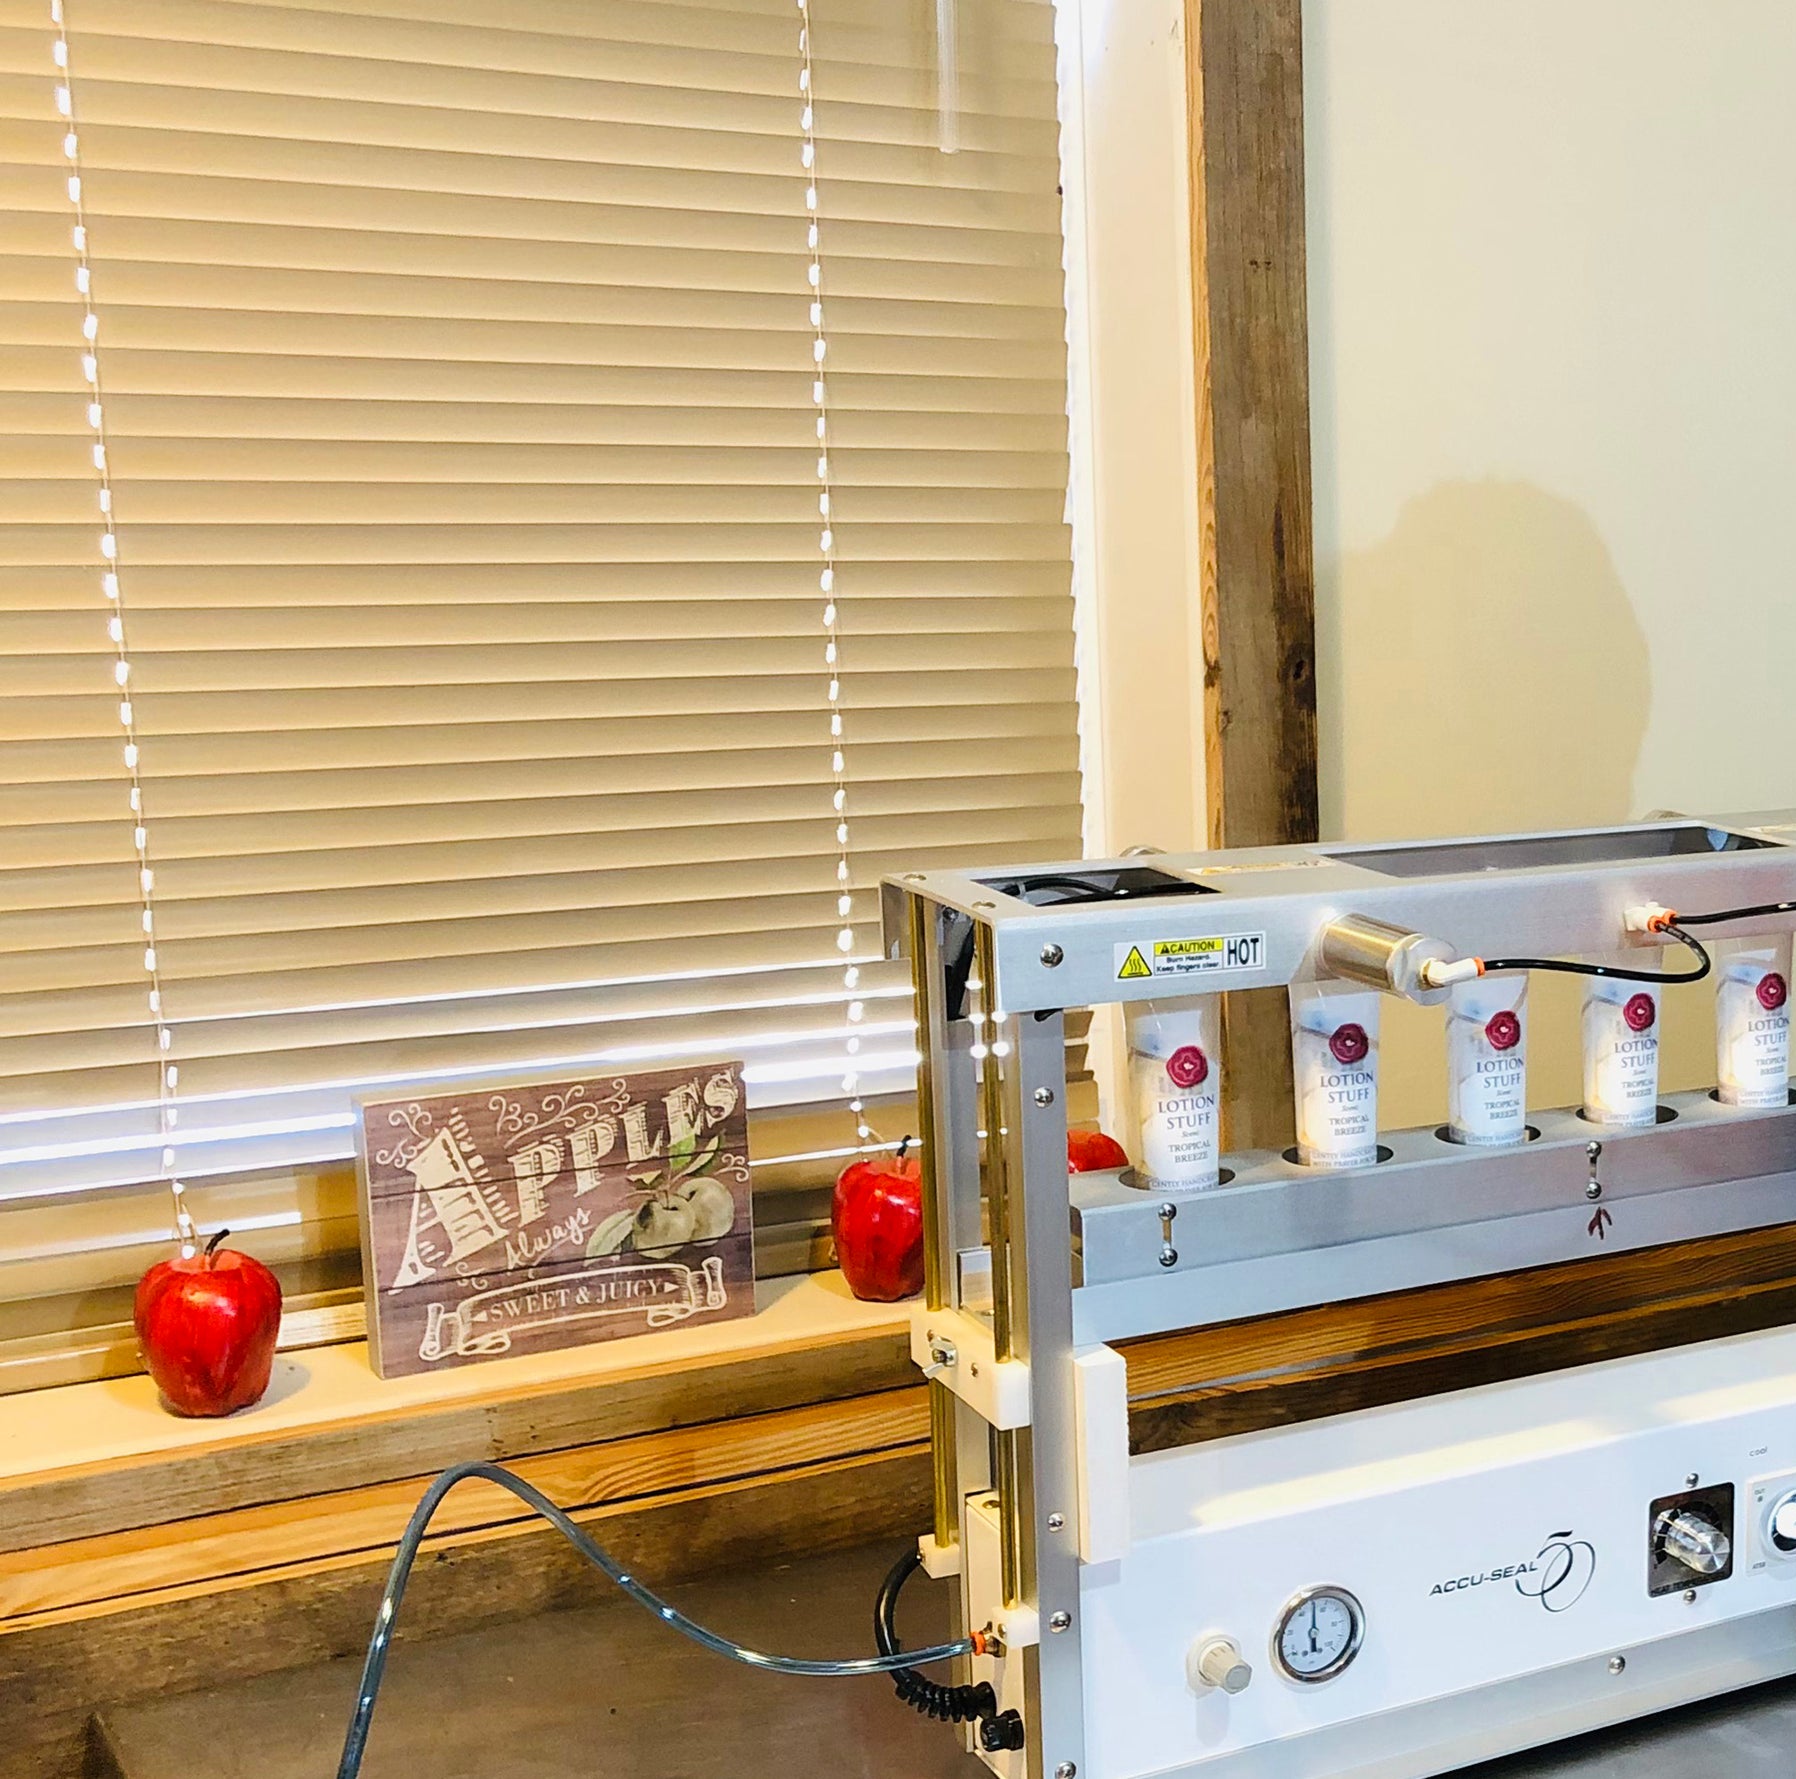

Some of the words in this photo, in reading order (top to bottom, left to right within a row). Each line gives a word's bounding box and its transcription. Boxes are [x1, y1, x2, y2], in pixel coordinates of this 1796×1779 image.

[1170, 941, 1215, 954] CAUTION
[1227, 937, 1260, 966] HOT
[1176, 962, 1200, 973] fingers
[1748, 1016, 1790, 1033] LOTION
[1614, 1038, 1658, 1054] LOTION
[1754, 1031, 1787, 1047] STUFF
[1476, 1057, 1524, 1074] LOTION
[1621, 1052, 1655, 1069] STUFF
[1320, 1070, 1374, 1088] LOTION
[1484, 1072, 1521, 1089] STUFF
[1158, 1093, 1215, 1114] LOTION
[1327, 1087, 1370, 1104] STUFF
[1167, 1111, 1211, 1130] STUFF
[1328, 1114, 1370, 1126] TROPICAL
[1334, 1125, 1367, 1137] BREEZE
[1168, 1139, 1211, 1153] TROPICAL
[1174, 1150, 1209, 1164] BREEZE
[388, 1068, 742, 1296] APPLES
[505, 1206, 597, 1271] Always
[490, 1287, 571, 1323] SWEET
[575, 1285, 592, 1308] &
[594, 1277, 662, 1308] JUICY
[1748, 1446, 1768, 1457] cool
[1429, 1561, 1539, 1597] ACCU-SEAL
